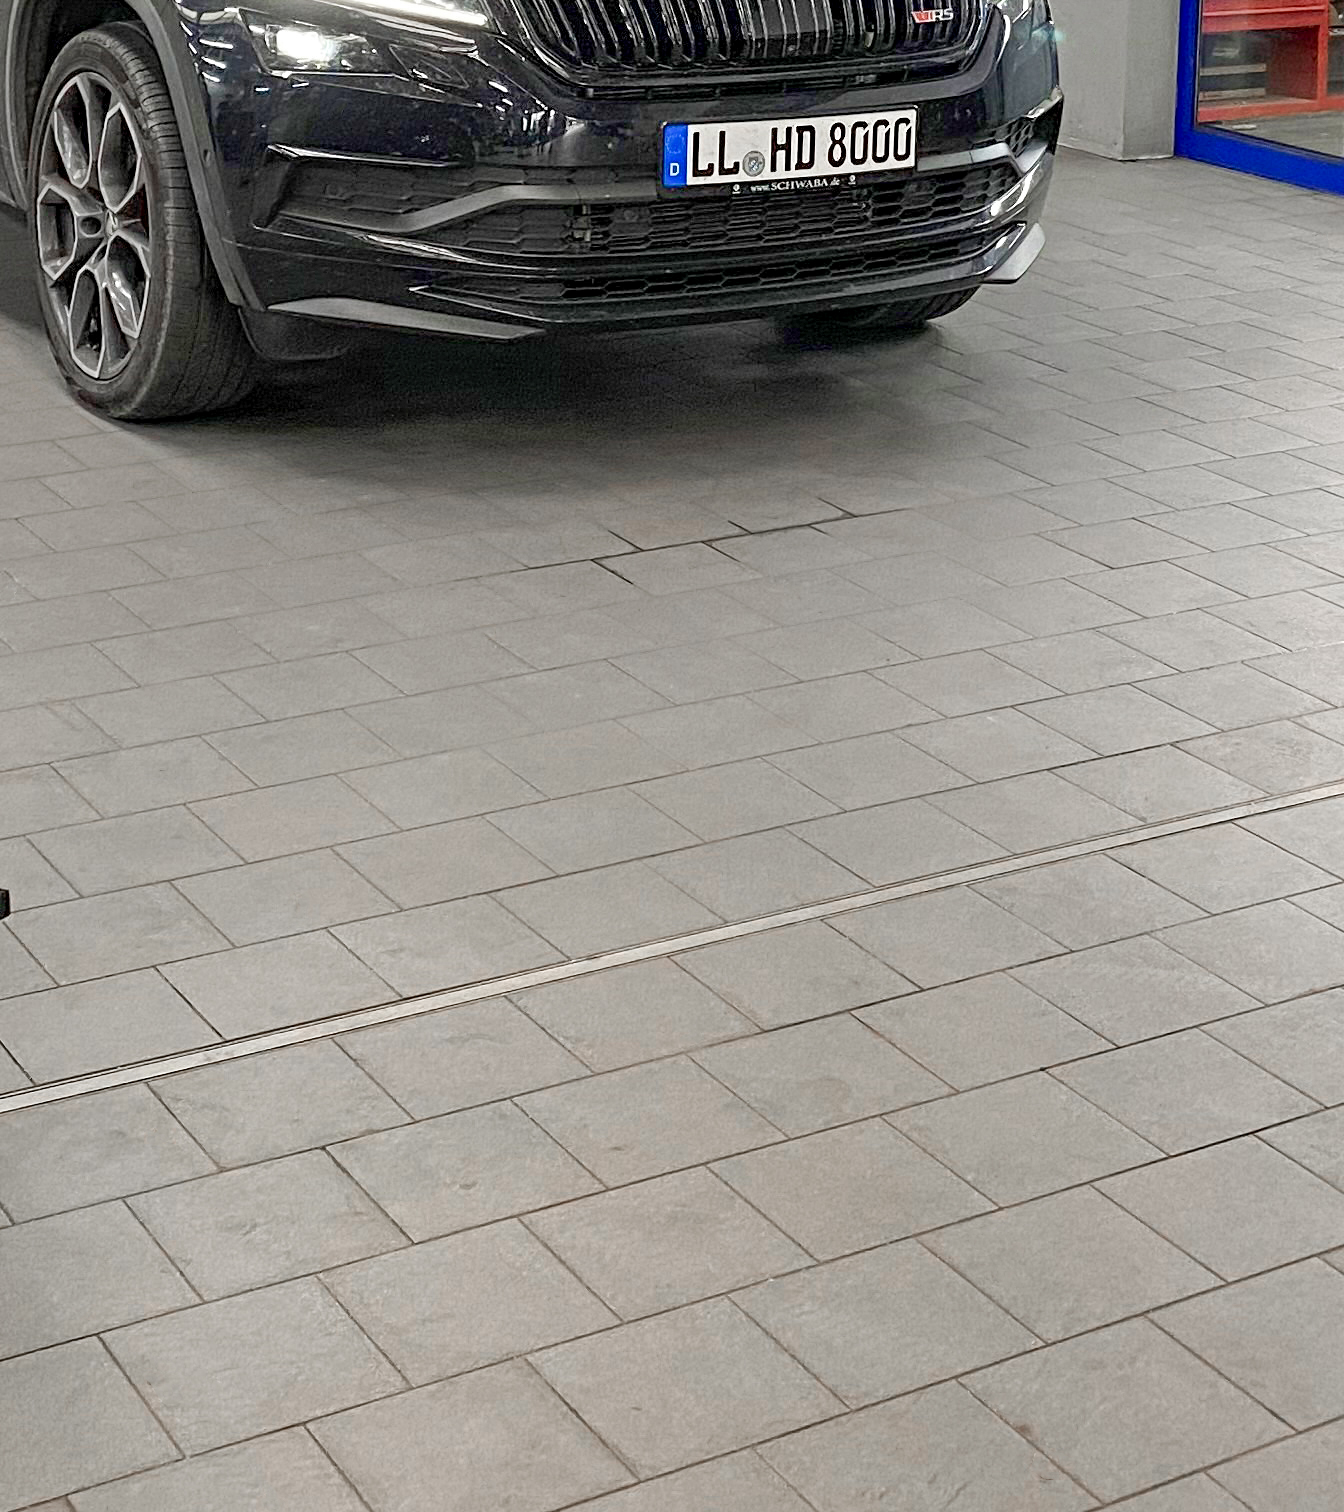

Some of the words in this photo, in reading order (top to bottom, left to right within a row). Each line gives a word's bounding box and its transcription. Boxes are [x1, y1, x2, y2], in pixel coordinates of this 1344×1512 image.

[669, 162, 681, 178] D
[691, 130, 740, 178] LL
[770, 124, 816, 173] HD
[827, 116, 913, 169] 8000
